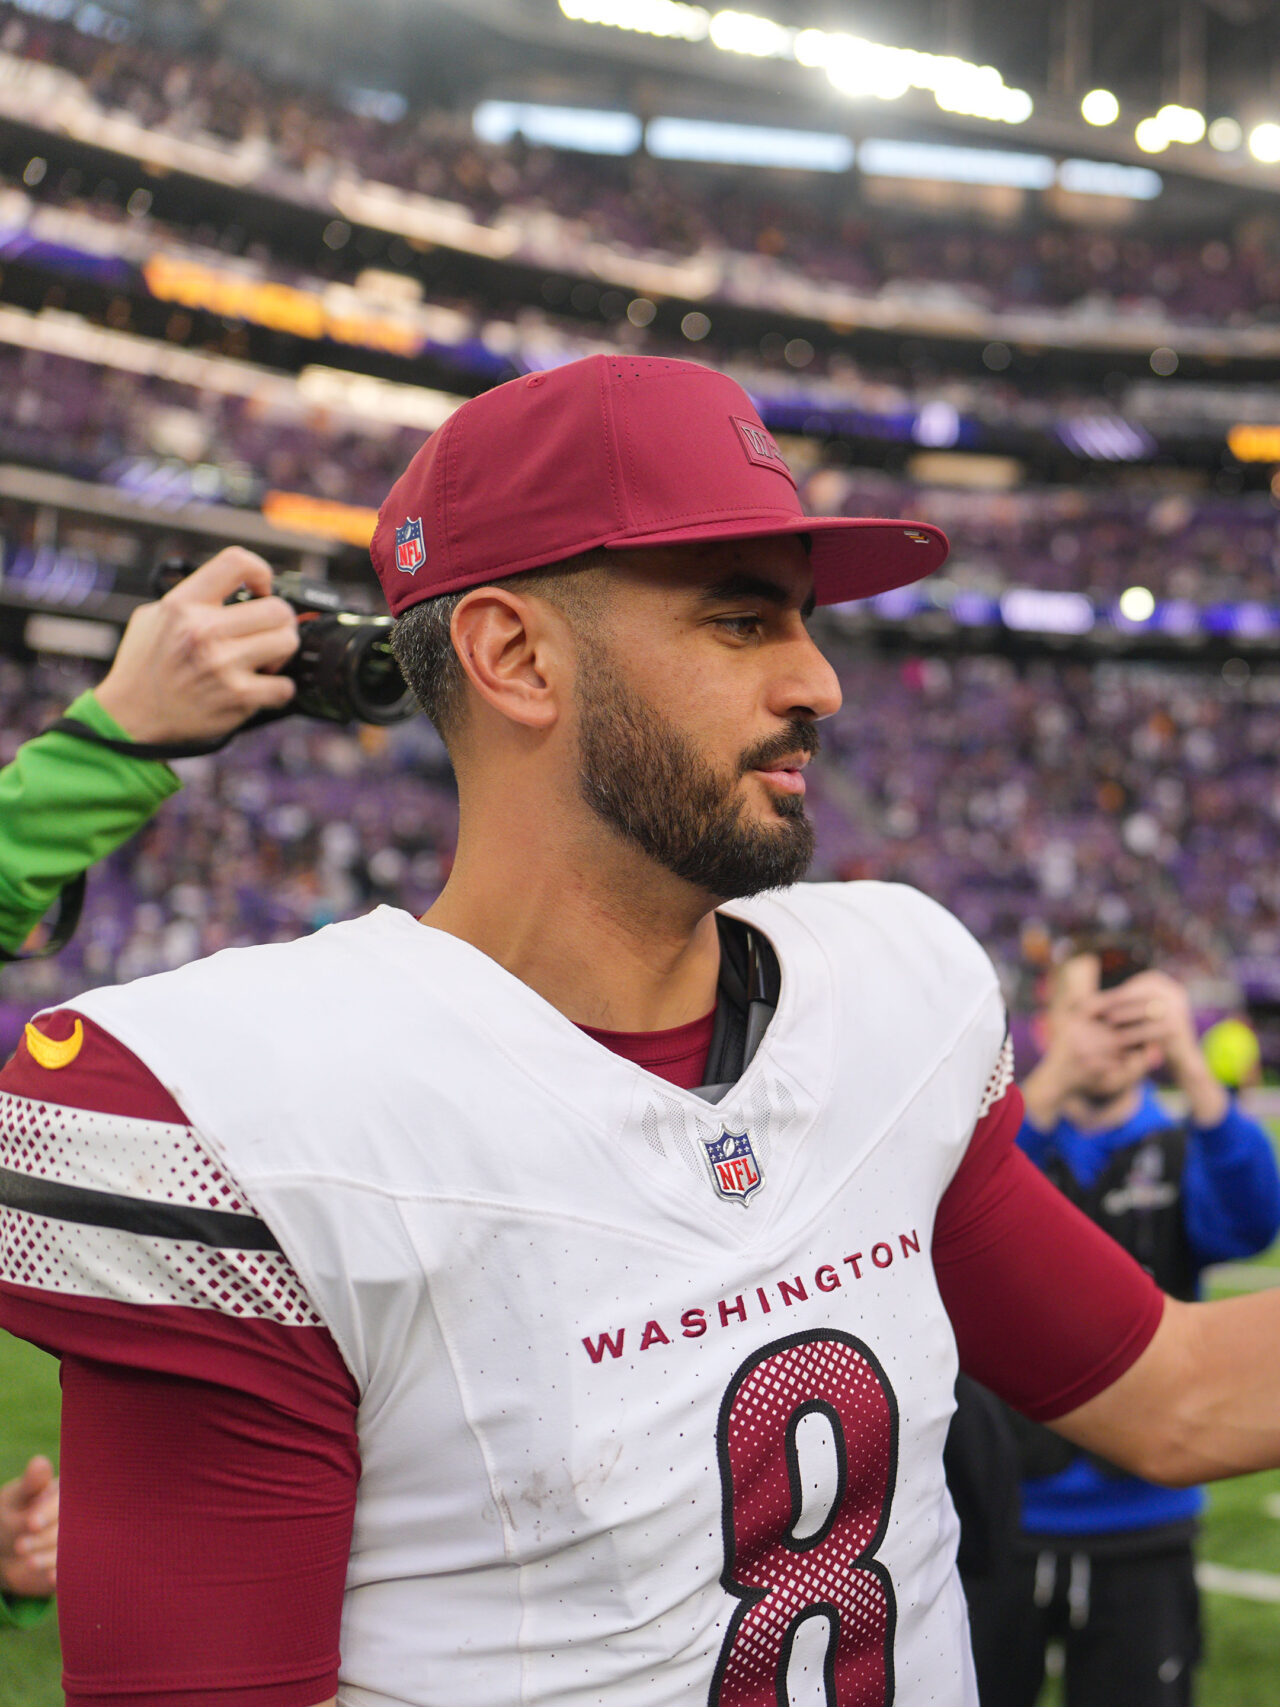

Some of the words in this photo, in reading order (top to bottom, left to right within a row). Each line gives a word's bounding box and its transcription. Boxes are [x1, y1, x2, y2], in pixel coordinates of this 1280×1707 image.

[398, 539, 422, 567] NFL
[717, 1157, 758, 1191] NFL
[581, 1229, 921, 1364] WASHINGTON
[707, 1328, 900, 1707] 8
